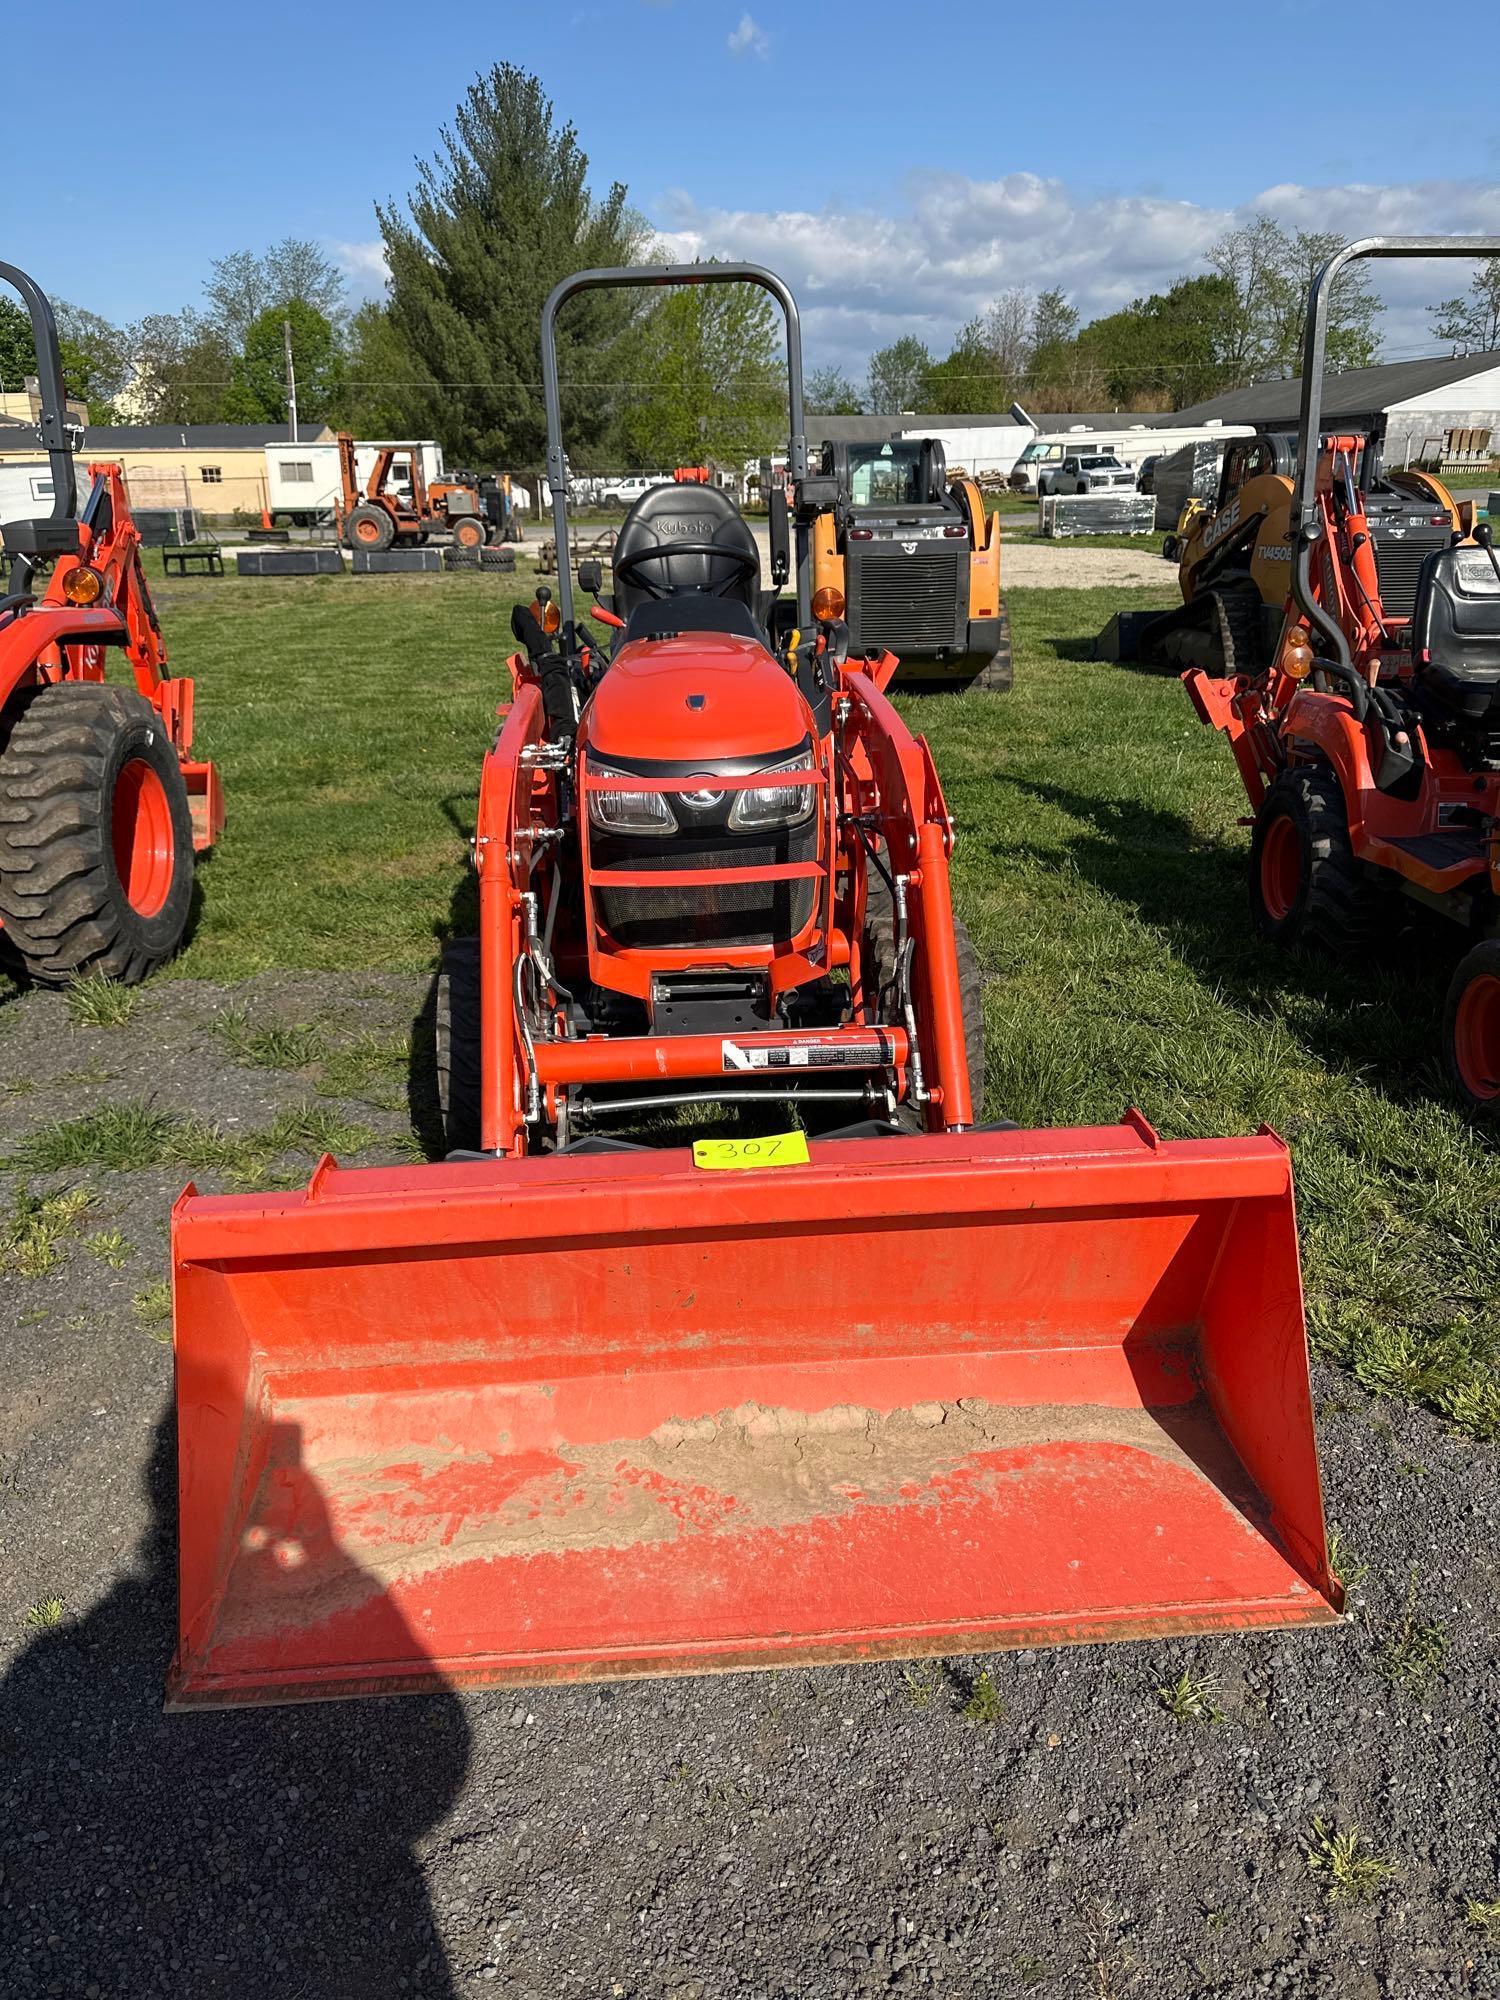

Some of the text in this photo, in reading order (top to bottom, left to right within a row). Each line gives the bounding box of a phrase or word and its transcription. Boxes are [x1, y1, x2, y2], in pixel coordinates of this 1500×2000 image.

[656, 520, 714, 535] Kubota
[1203, 502, 1241, 548] CASE
[717, 1140, 782, 1159] 307
